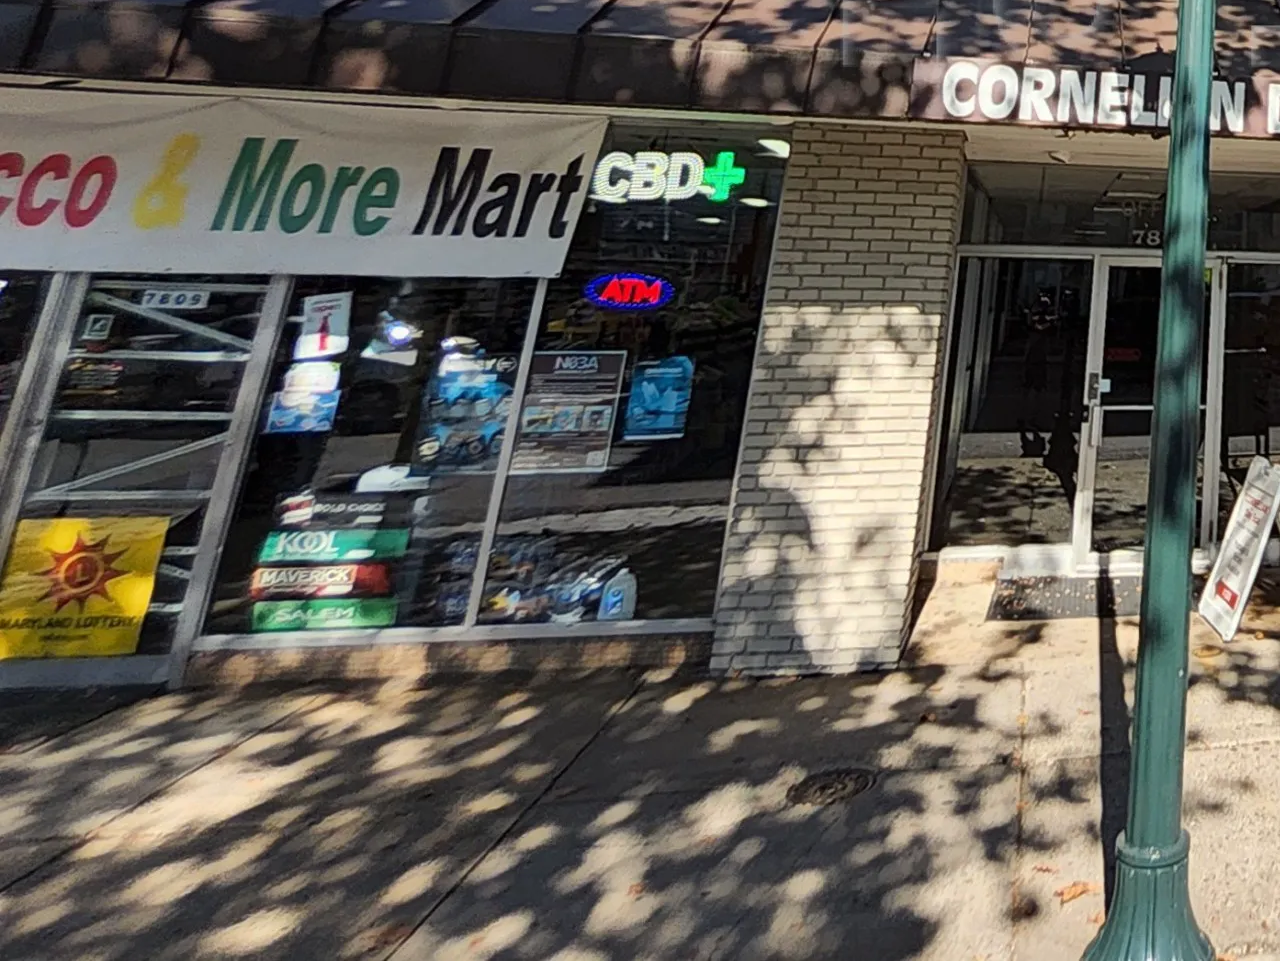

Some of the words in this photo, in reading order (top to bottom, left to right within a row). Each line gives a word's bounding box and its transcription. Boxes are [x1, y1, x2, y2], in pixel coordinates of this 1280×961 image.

[943, 61, 1246, 132] CORNELIN
[134, 133, 199, 230] &
[210, 137, 399, 236] More
[413, 146, 586, 239] Mart
[599, 276, 662, 303] ATM
[276, 531, 339, 554] KOOL
[261, 568, 350, 585] MAVERICK
[274, 606, 356, 622] SALEM
